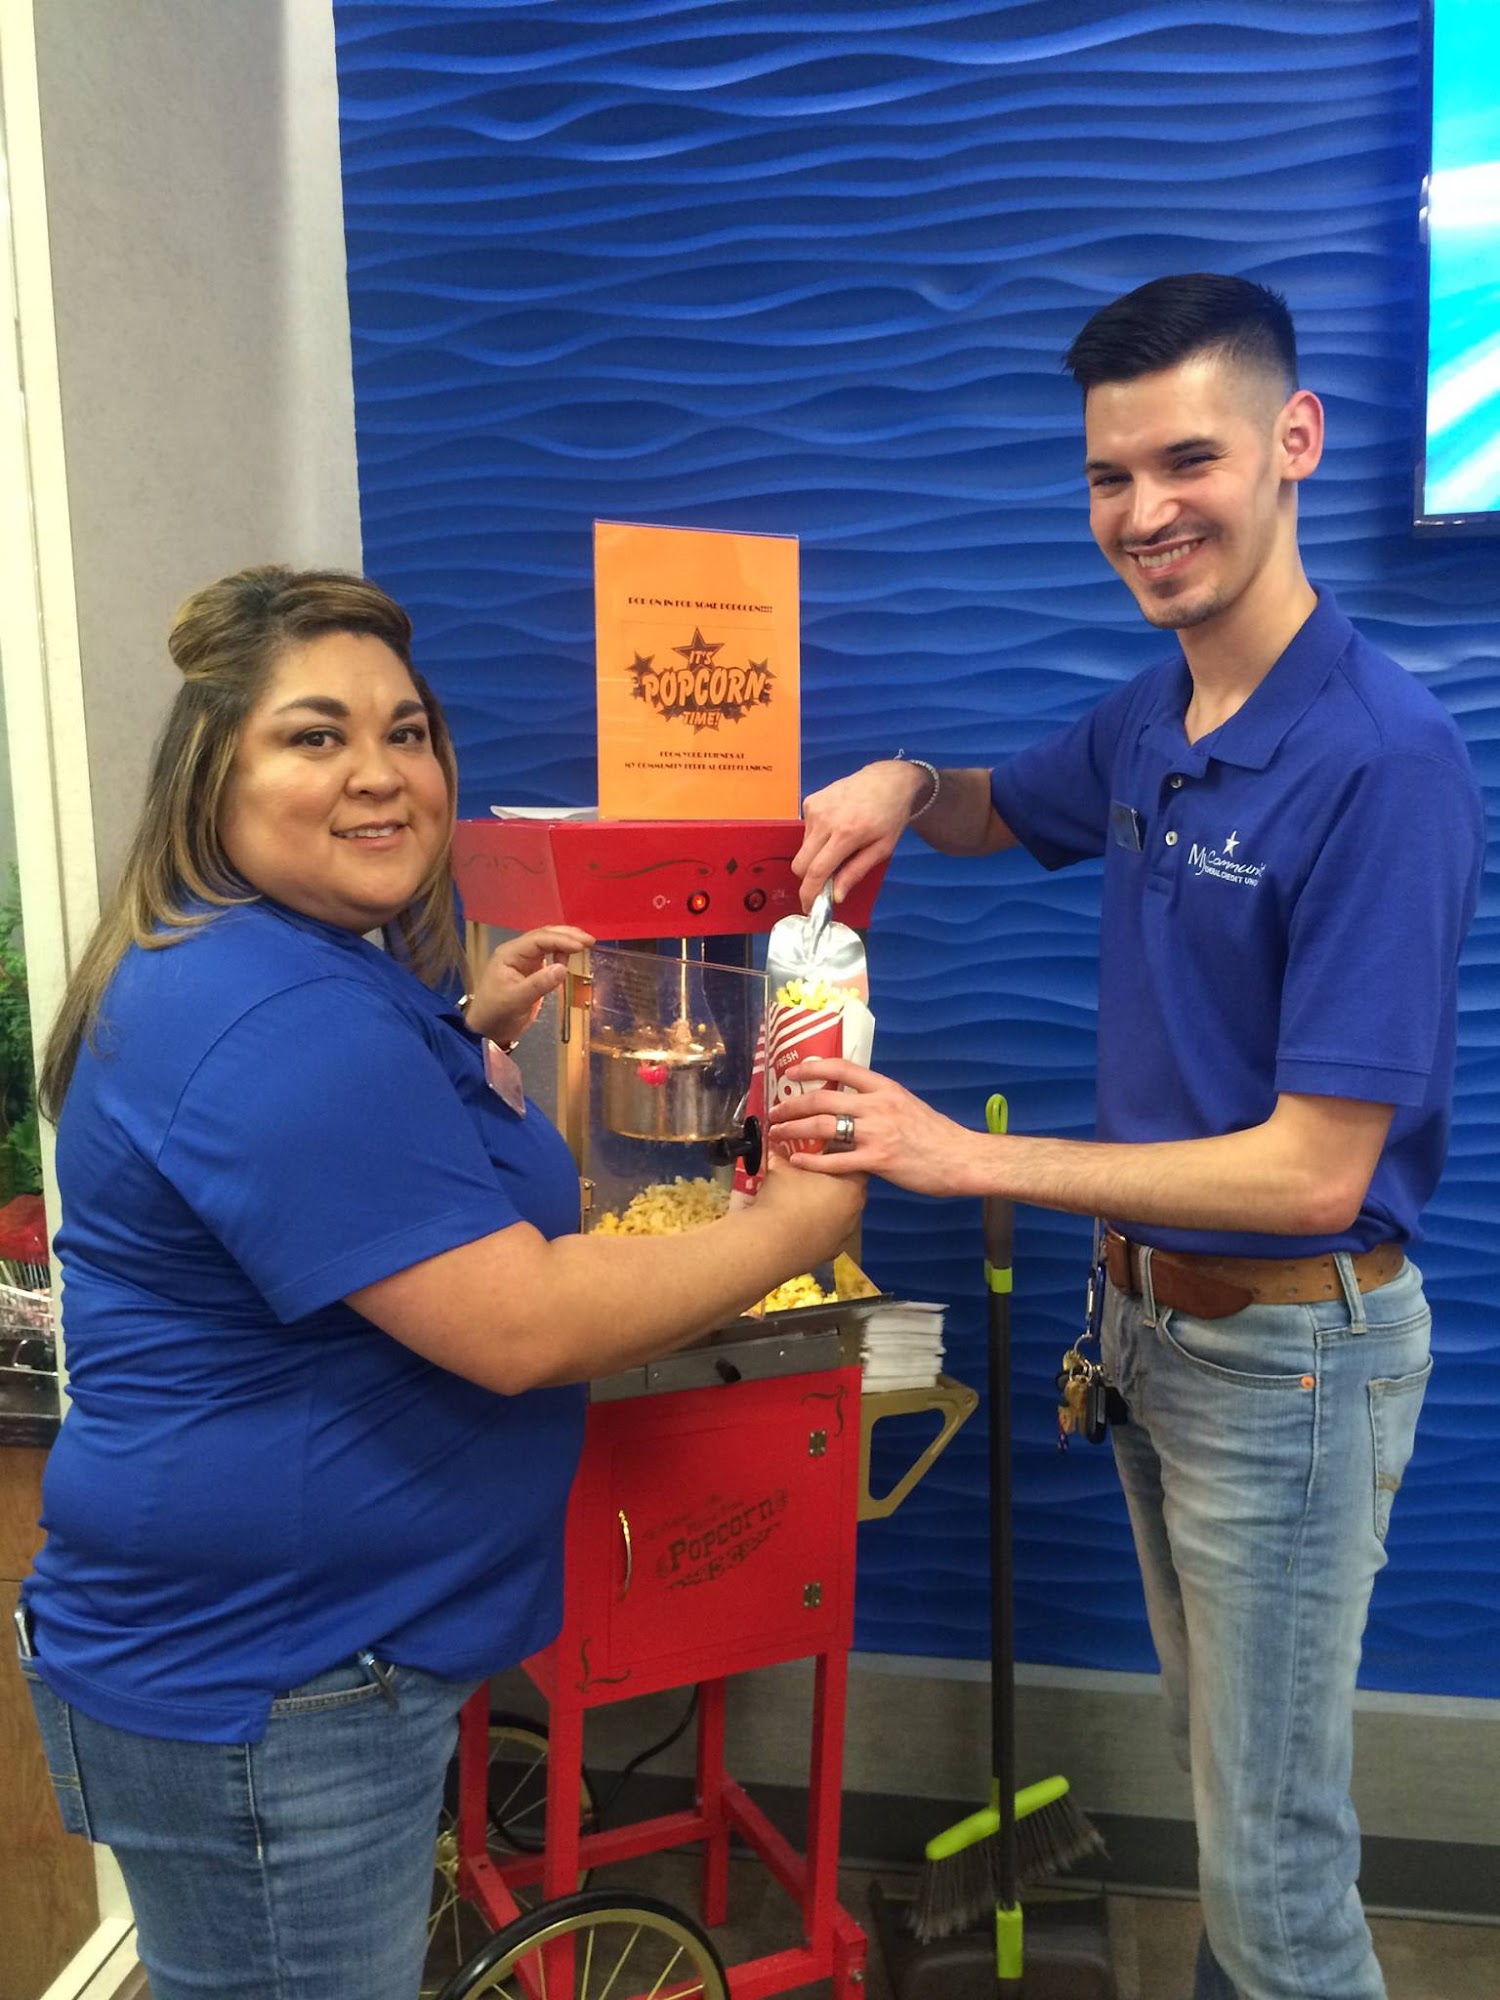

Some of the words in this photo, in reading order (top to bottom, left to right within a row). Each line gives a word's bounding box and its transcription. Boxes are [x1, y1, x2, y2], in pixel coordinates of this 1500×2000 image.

[649, 598, 662, 607] ON
[695, 601, 718, 610] SOME
[689, 650, 714, 665] IT'S
[642, 668, 767, 707] POPCORN
[682, 711, 721, 727] TIME!
[704, 752, 734, 760] FRIENDS
[637, 762, 683, 770] COMMUNITY
[684, 763, 716, 771] FEDERAL
[718, 764, 744, 772] CREDIT
[776, 1049, 799, 1070] FRESH
